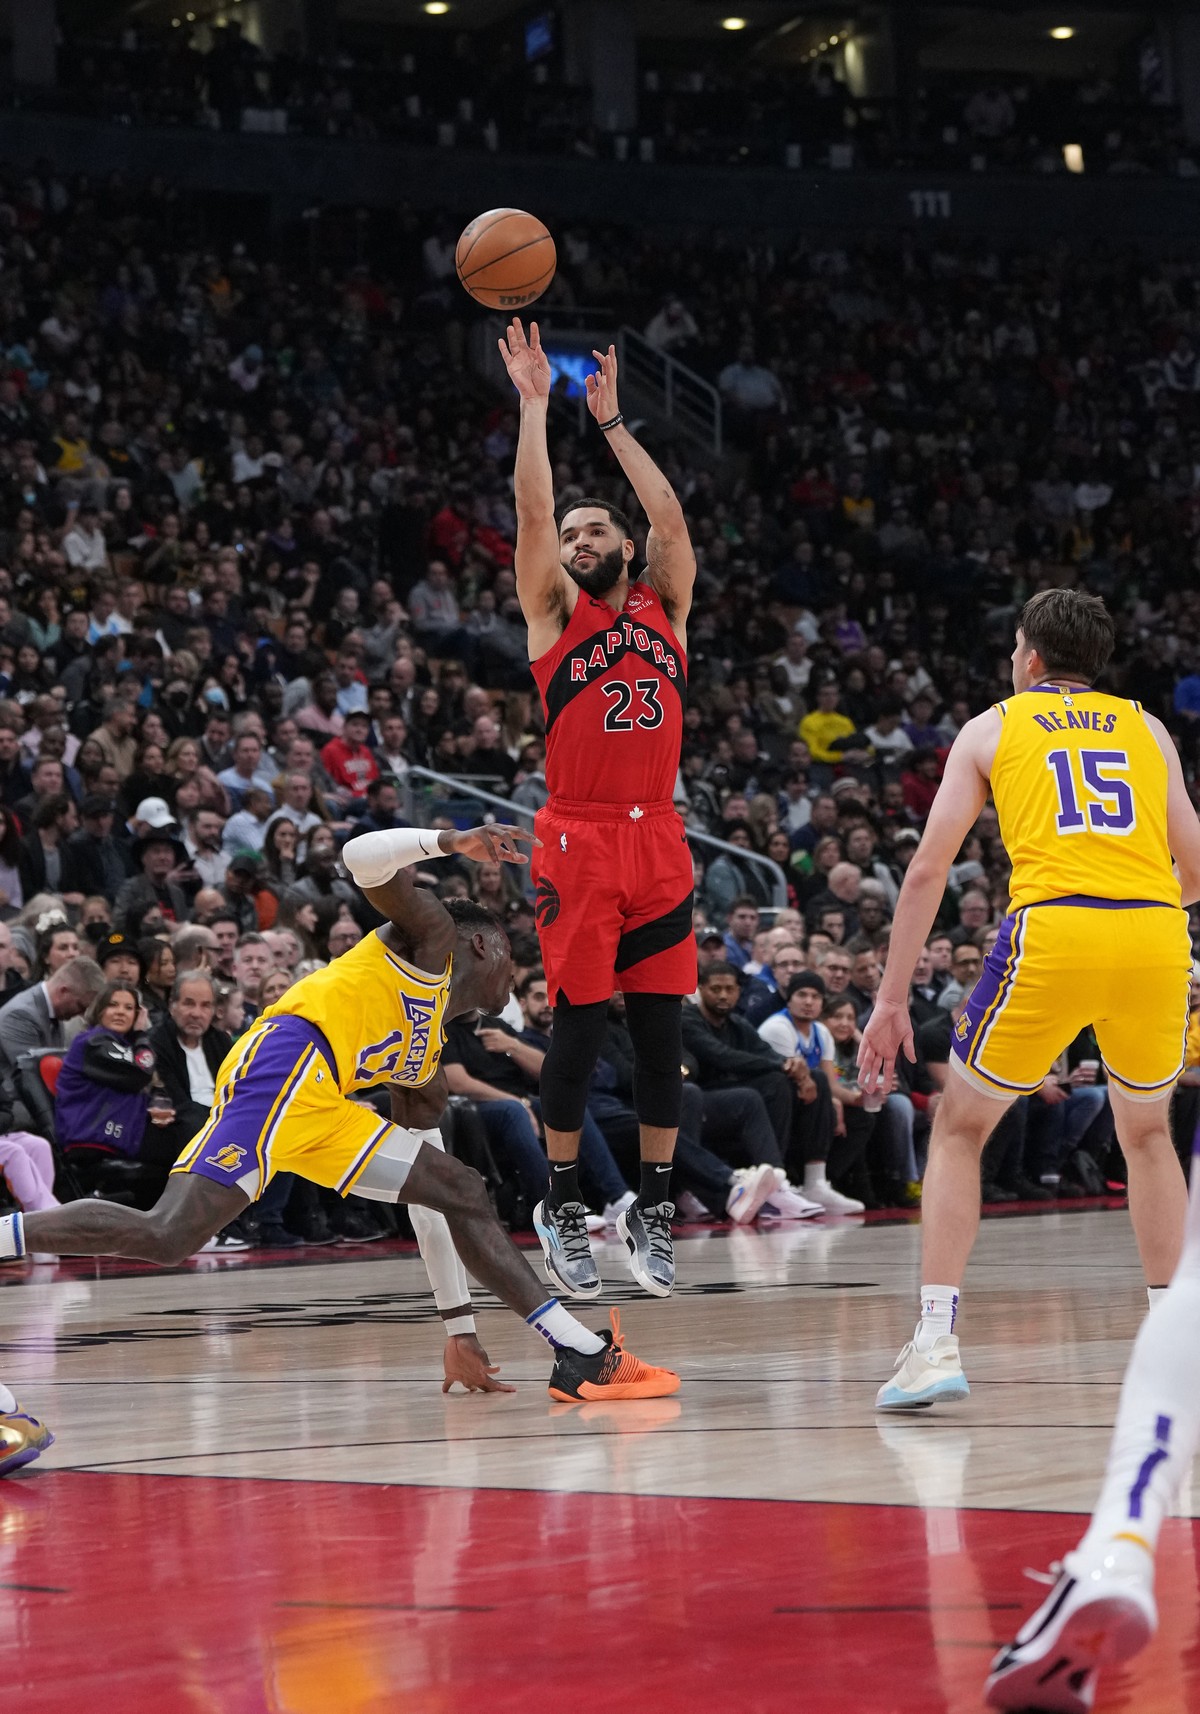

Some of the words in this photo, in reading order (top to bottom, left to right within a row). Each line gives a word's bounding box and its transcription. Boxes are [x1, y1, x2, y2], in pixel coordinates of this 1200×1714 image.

[909, 190, 950, 218] 111
[571, 622, 677, 682] RAPTORS
[601, 678, 664, 732] 23
[1032, 710, 1117, 734] REAVES
[1045, 747, 1137, 837] 15
[354, 1029, 404, 1084] 17
[390, 989, 437, 1083] LAKERS
[104, 1120, 124, 1139] 95
